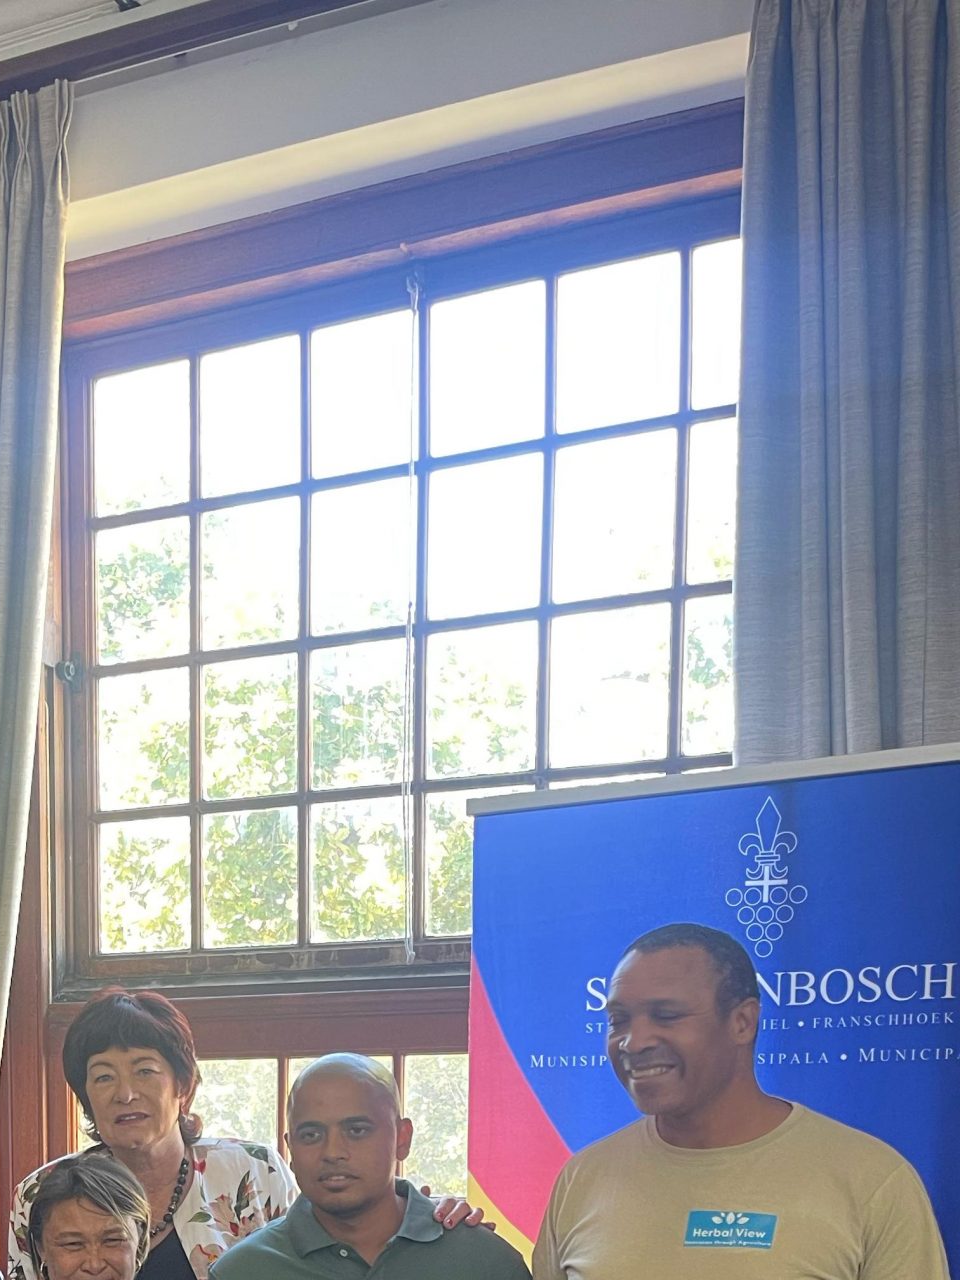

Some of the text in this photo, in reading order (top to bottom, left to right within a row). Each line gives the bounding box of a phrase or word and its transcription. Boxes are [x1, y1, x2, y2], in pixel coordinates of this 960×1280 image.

[585, 962, 957, 1012] SNBOSCH
[762, 1012, 954, 1030] IEL FRANSCHHOEK
[530, 1047, 960, 1068] MUNISIP SIPALA MUNICIP
[693, 1228, 766, 1238] Herbal View
